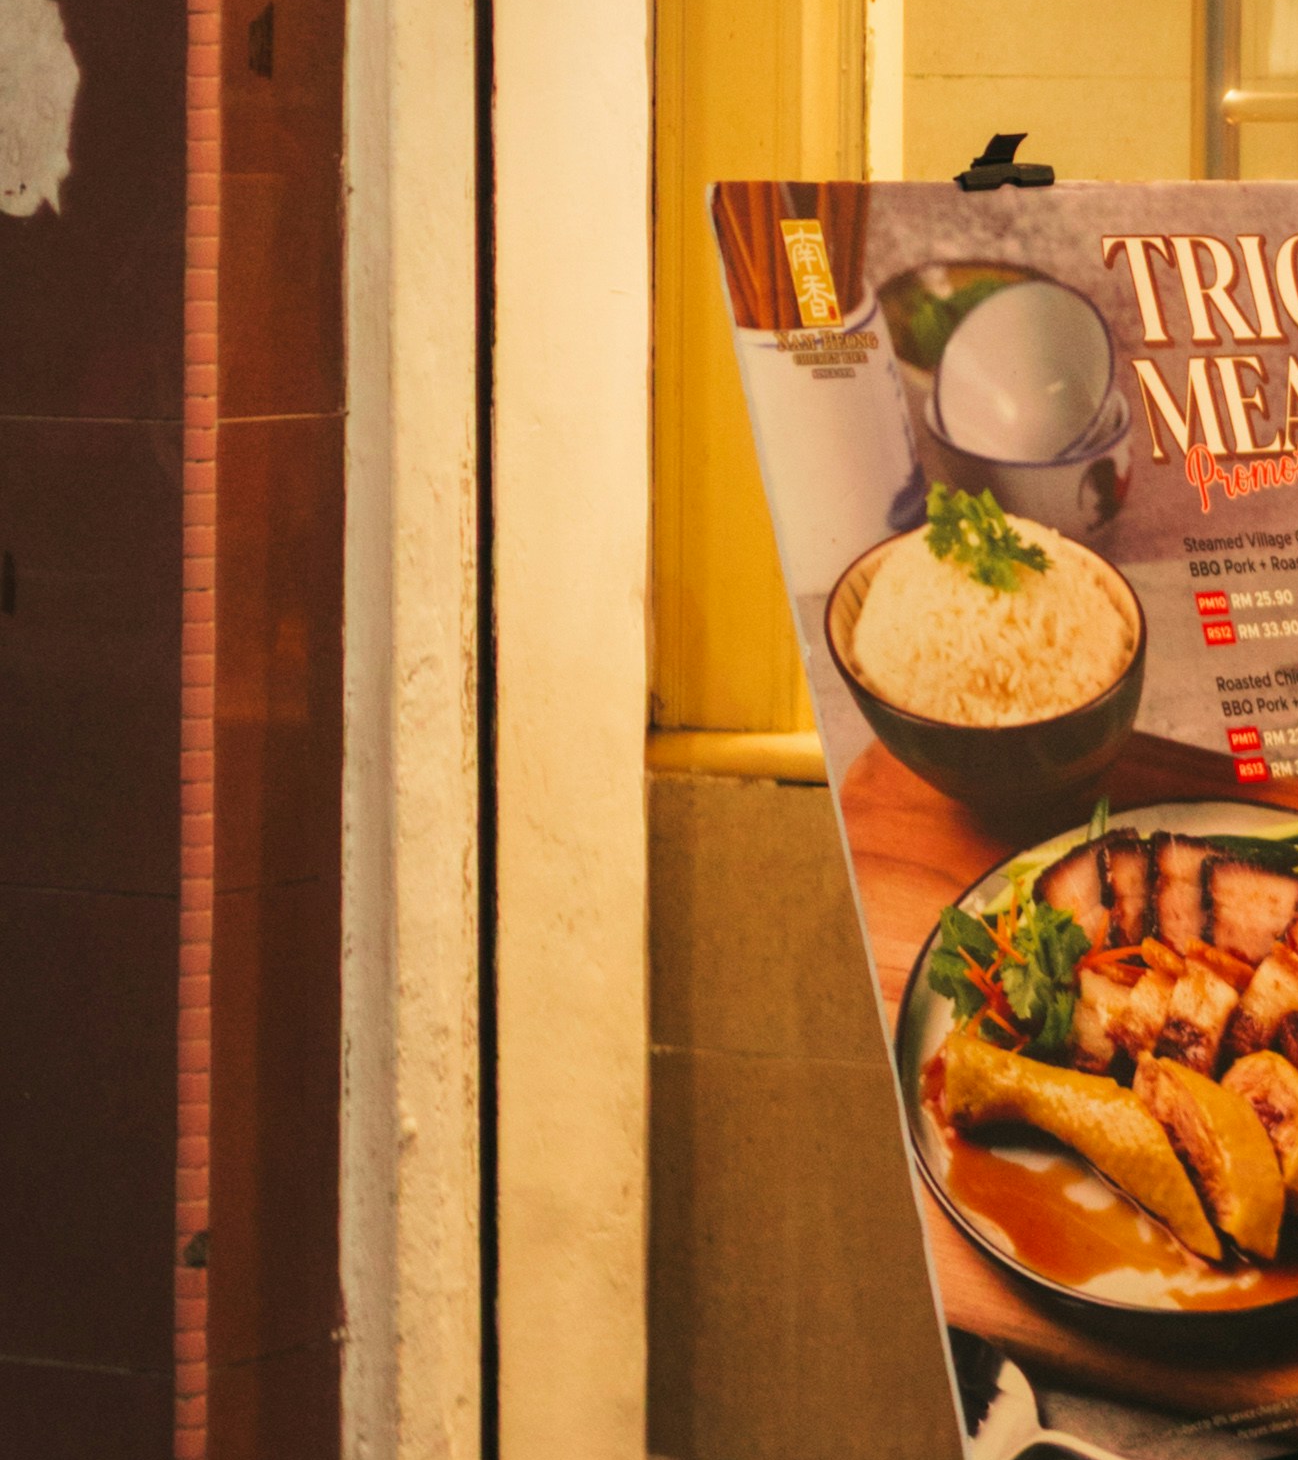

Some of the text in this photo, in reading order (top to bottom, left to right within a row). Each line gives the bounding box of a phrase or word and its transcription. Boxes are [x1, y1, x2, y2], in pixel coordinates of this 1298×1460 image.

[783, 226, 838, 320] 南香
[1183, 534, 1243, 553] Steamed
[1247, 531, 1292, 550] Village
[1189, 560, 1221, 577] BBQ
[1225, 558, 1256, 575] Pork
[1198, 596, 1227, 611] PM10
[1230, 592, 1253, 609] RM
[1255, 589, 1293, 608] 25.90
[1237, 623, 1260, 639] RM
[1216, 673, 1272, 692] Roasted
[1221, 699, 1254, 717] BBQ
[1257, 696, 1288, 713] Pork
[1231, 731, 1258, 746] PM11
[1263, 730, 1285, 747] RM
[1270, 762, 1293, 778] RM
